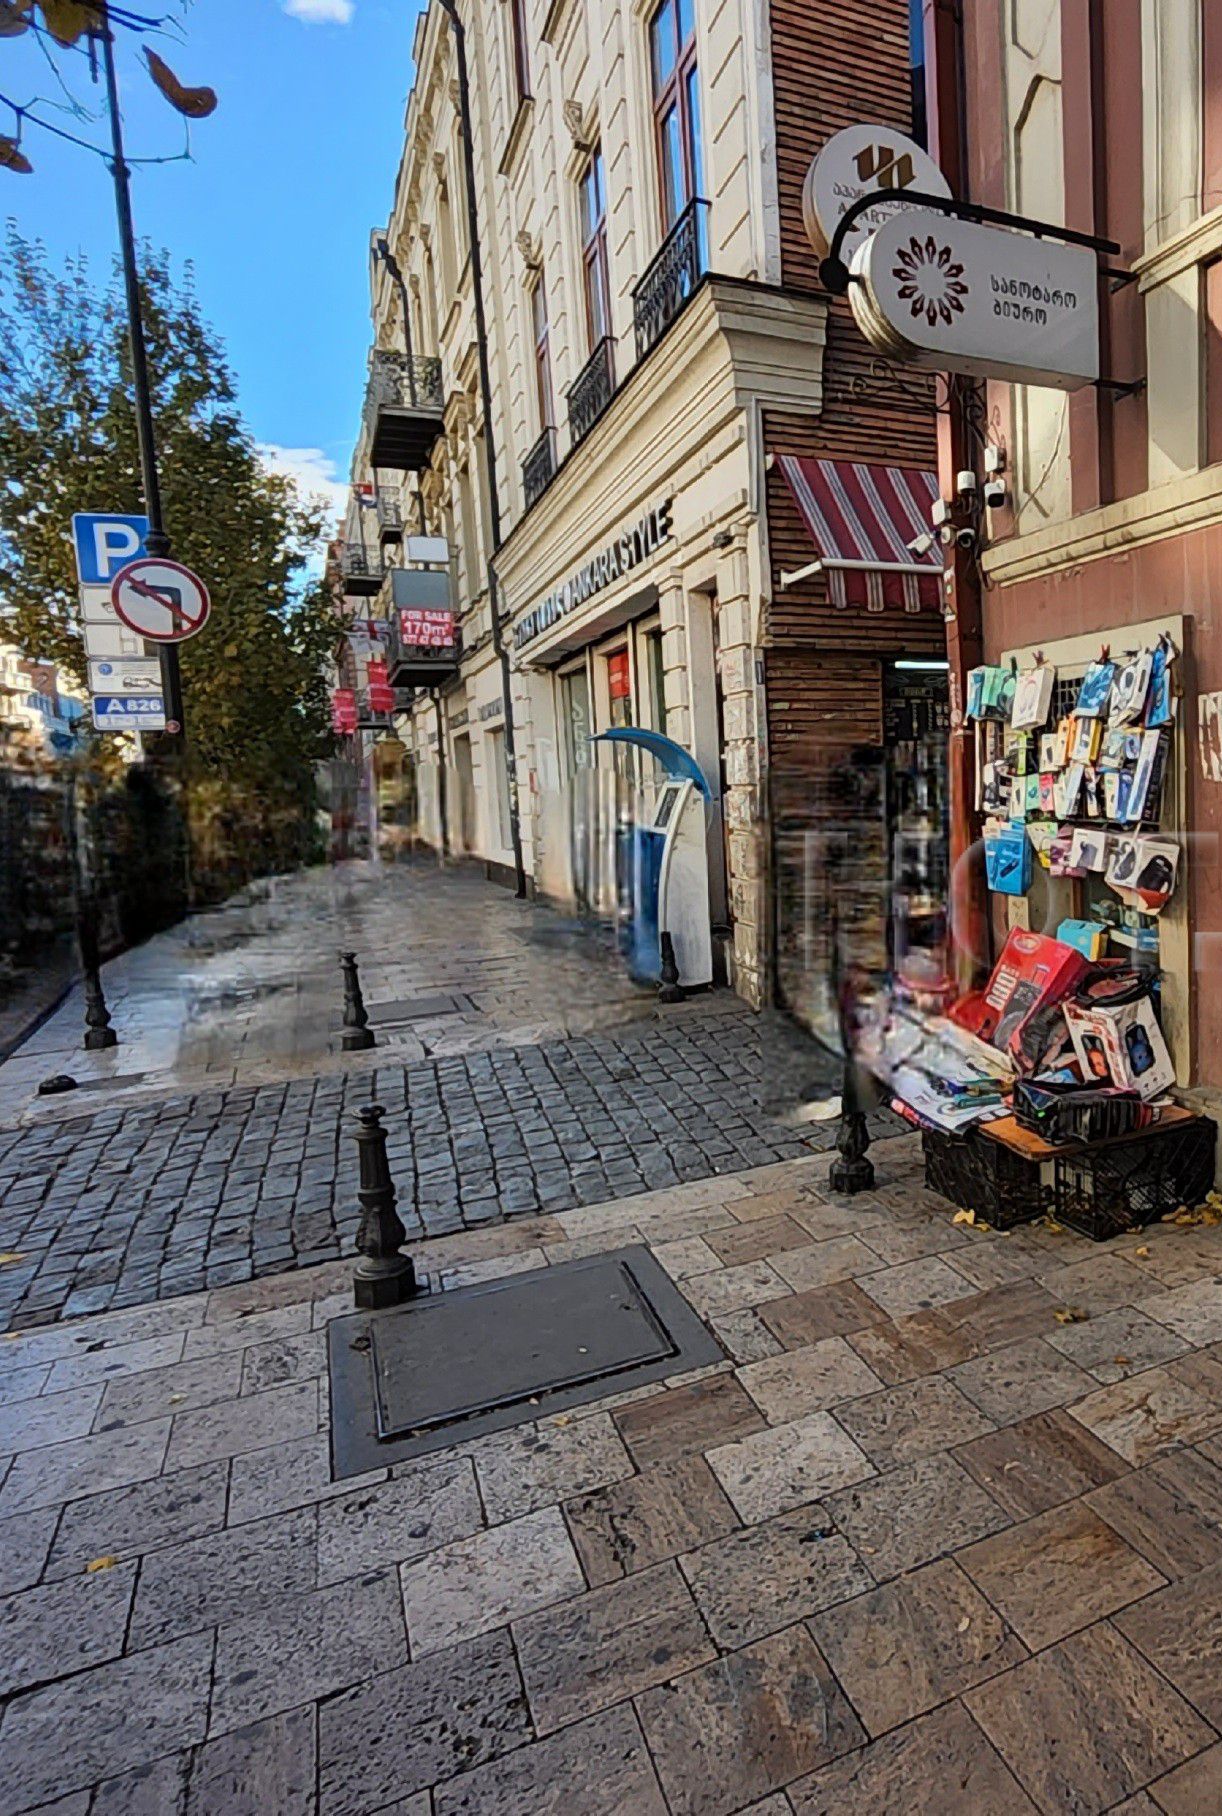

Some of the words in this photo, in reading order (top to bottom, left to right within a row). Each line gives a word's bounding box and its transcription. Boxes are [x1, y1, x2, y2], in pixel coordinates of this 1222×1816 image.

[990, 274, 1076, 308] სანოტარო
[993, 299, 1047, 325] ბიურო
[93, 522, 140, 577] P
[619, 500, 675, 571] STYLE
[425, 611, 450, 623] SALE
